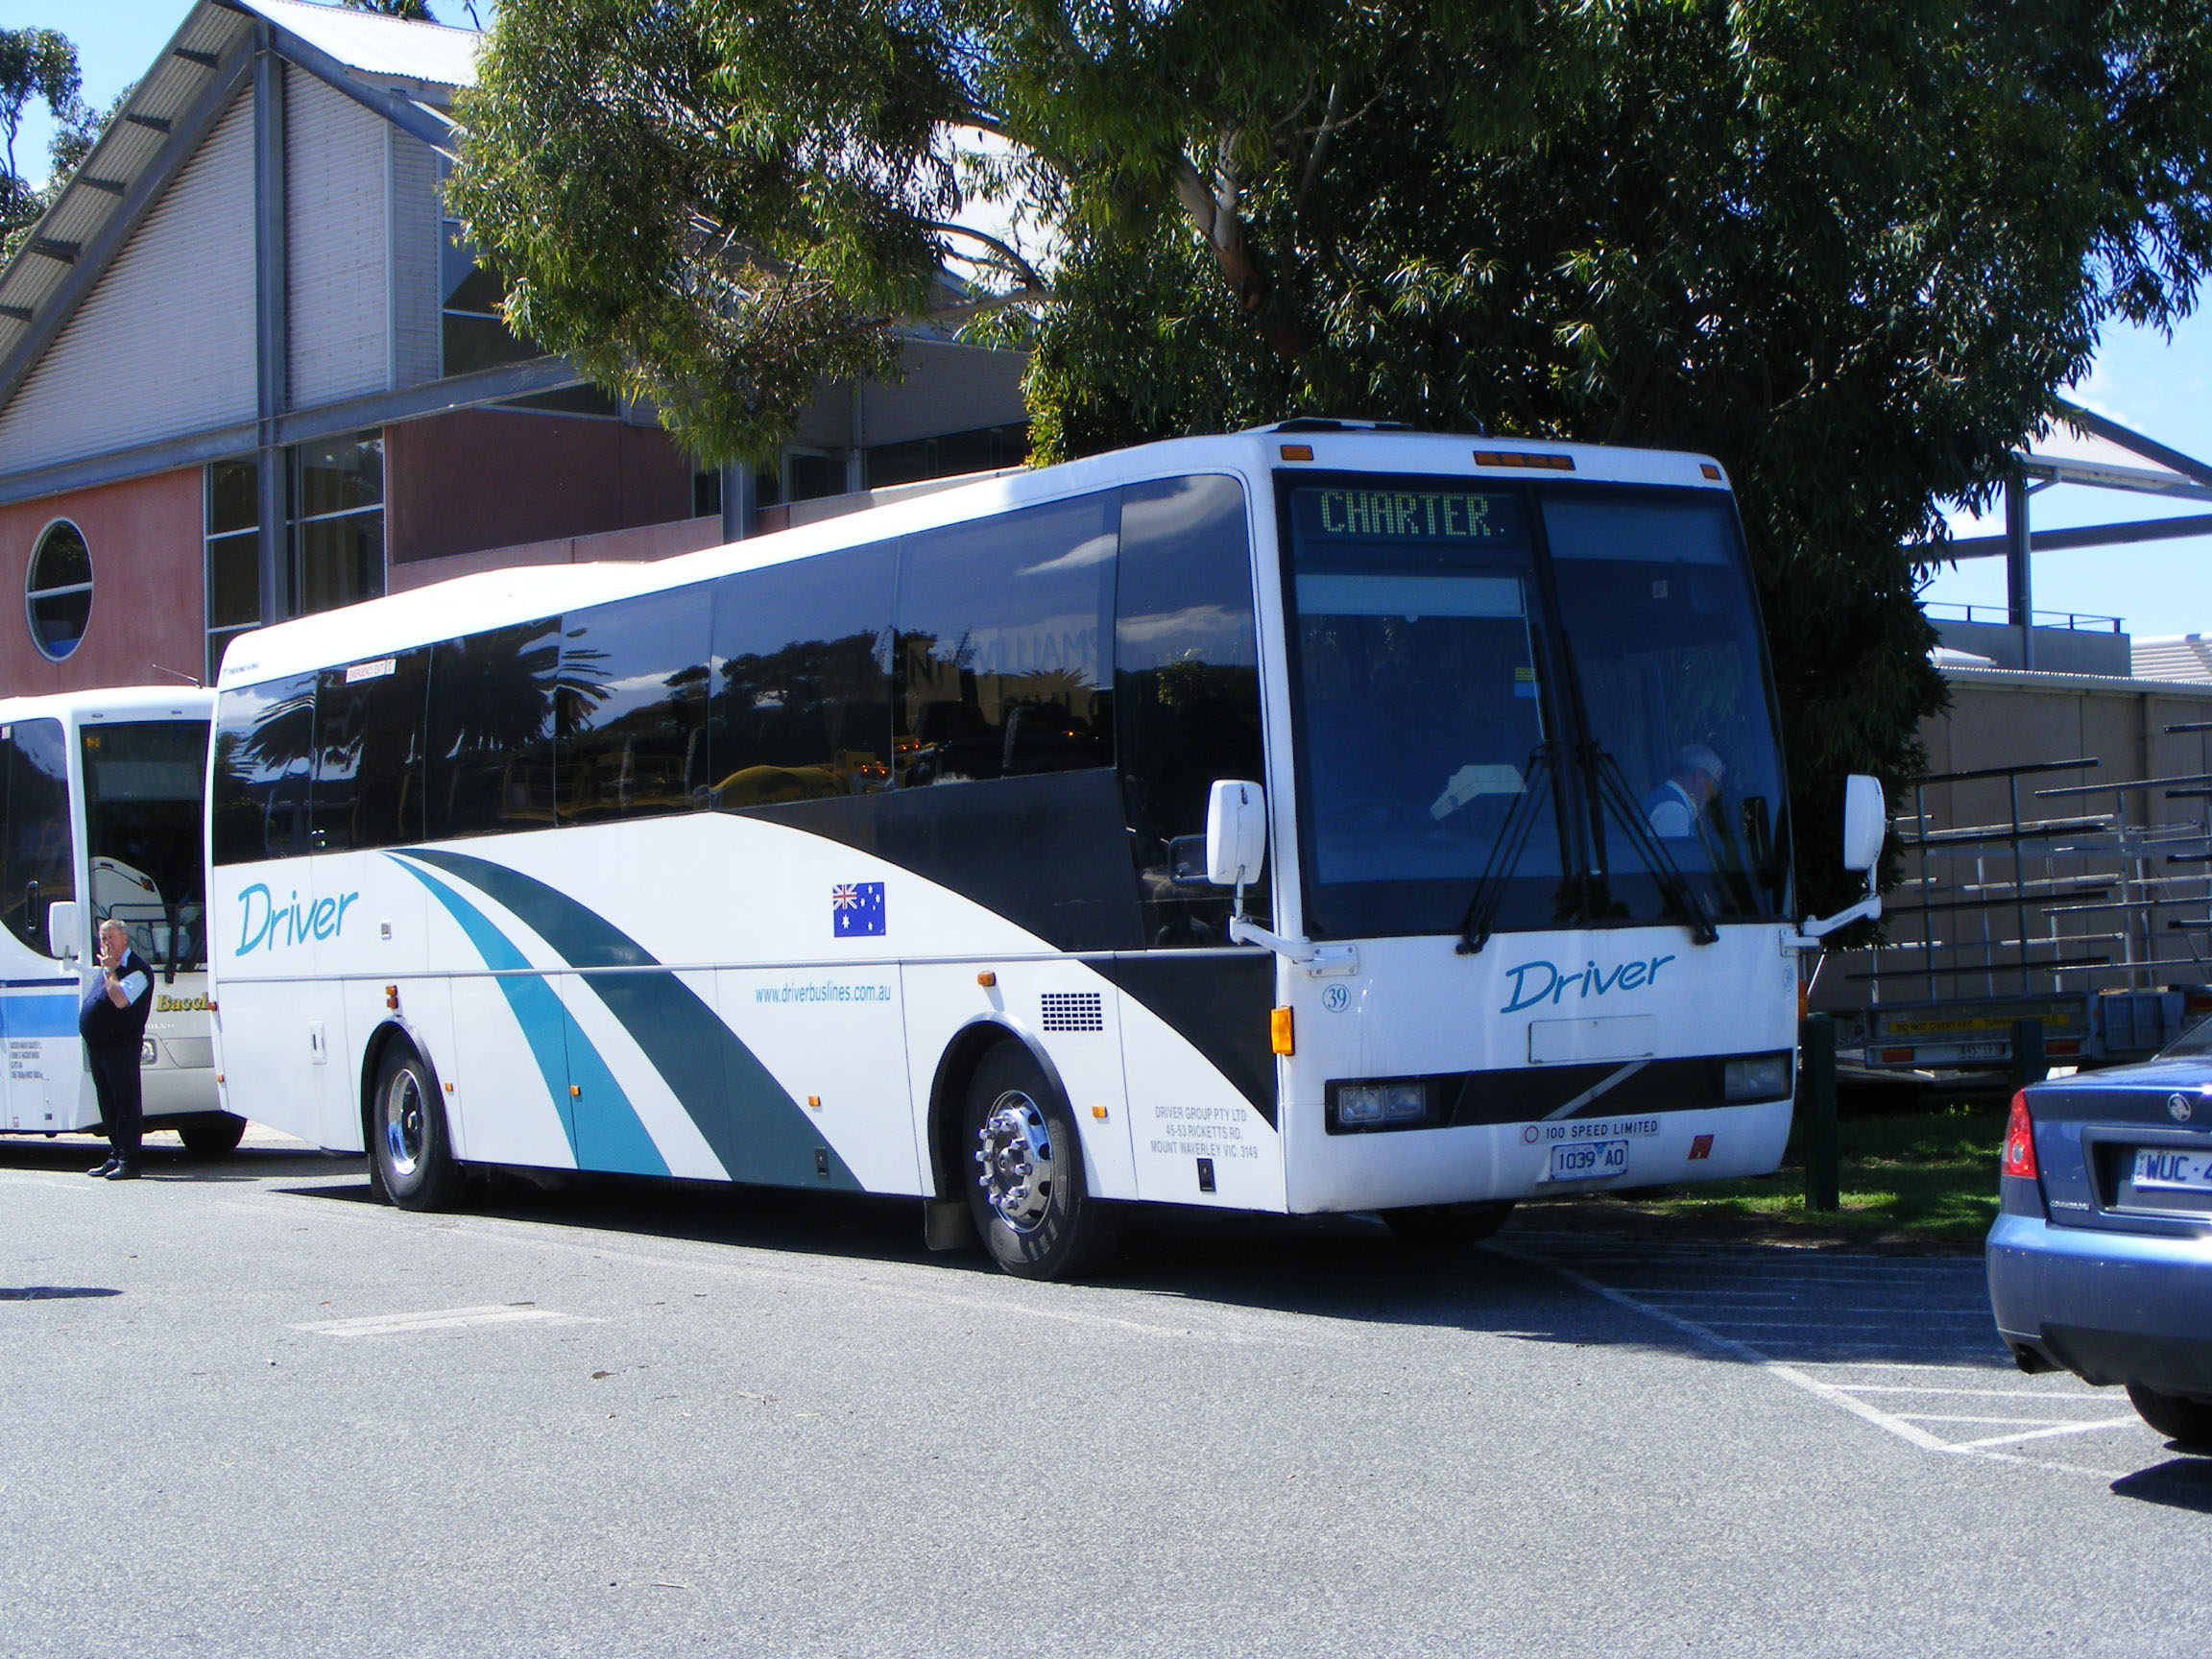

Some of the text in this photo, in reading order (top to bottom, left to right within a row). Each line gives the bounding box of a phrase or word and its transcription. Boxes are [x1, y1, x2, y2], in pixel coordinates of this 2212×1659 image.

[236, 883, 359, 956] Driver
[756, 980, 891, 1003] www.driverbuslines.com.au
[1501, 955, 1675, 1014] Driver
[1328, 988, 1347, 1008] 39
[146, 1022, 176, 1030] OLVO
[1155, 1105, 1247, 1122] DRIVER GROUP PTY LTD
[1166, 1124, 1187, 1138] 45-53
[1188, 1125, 1228, 1139] RICKETTS
[1546, 1120, 1658, 1140] 100 SPEED LIMITED
[1150, 1141, 1178, 1154] MOUNT
[1179, 1142, 1221, 1156] WAVERLEY
[1239, 1145, 1259, 1159] 3149
[1559, 1151, 1596, 1170] 1039
